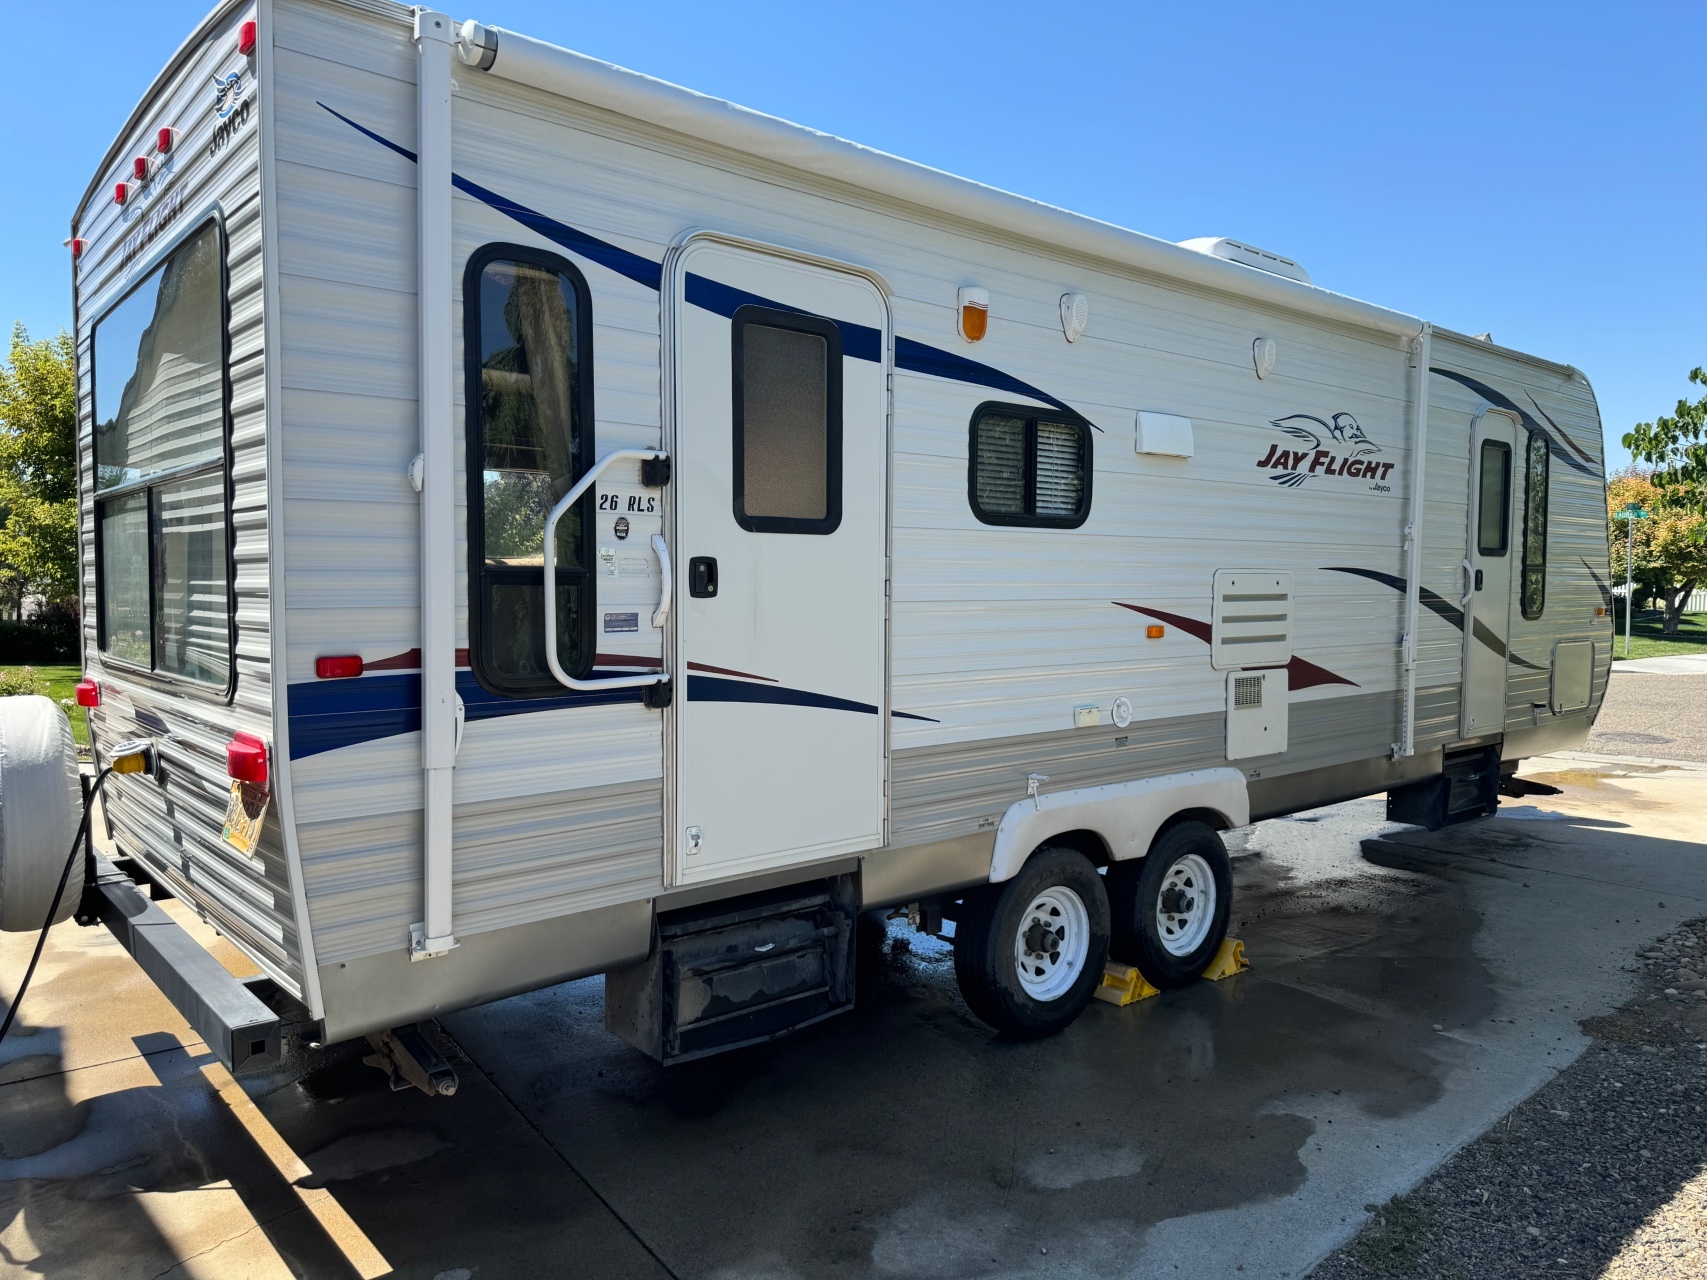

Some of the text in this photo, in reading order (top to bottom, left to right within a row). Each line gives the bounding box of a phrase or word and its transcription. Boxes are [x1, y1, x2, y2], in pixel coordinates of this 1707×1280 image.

[140, 180, 189, 252] FLIGHT
[1256, 444, 1395, 481] JAY FLIGHT
[599, 494, 656, 513] 26 RLS
